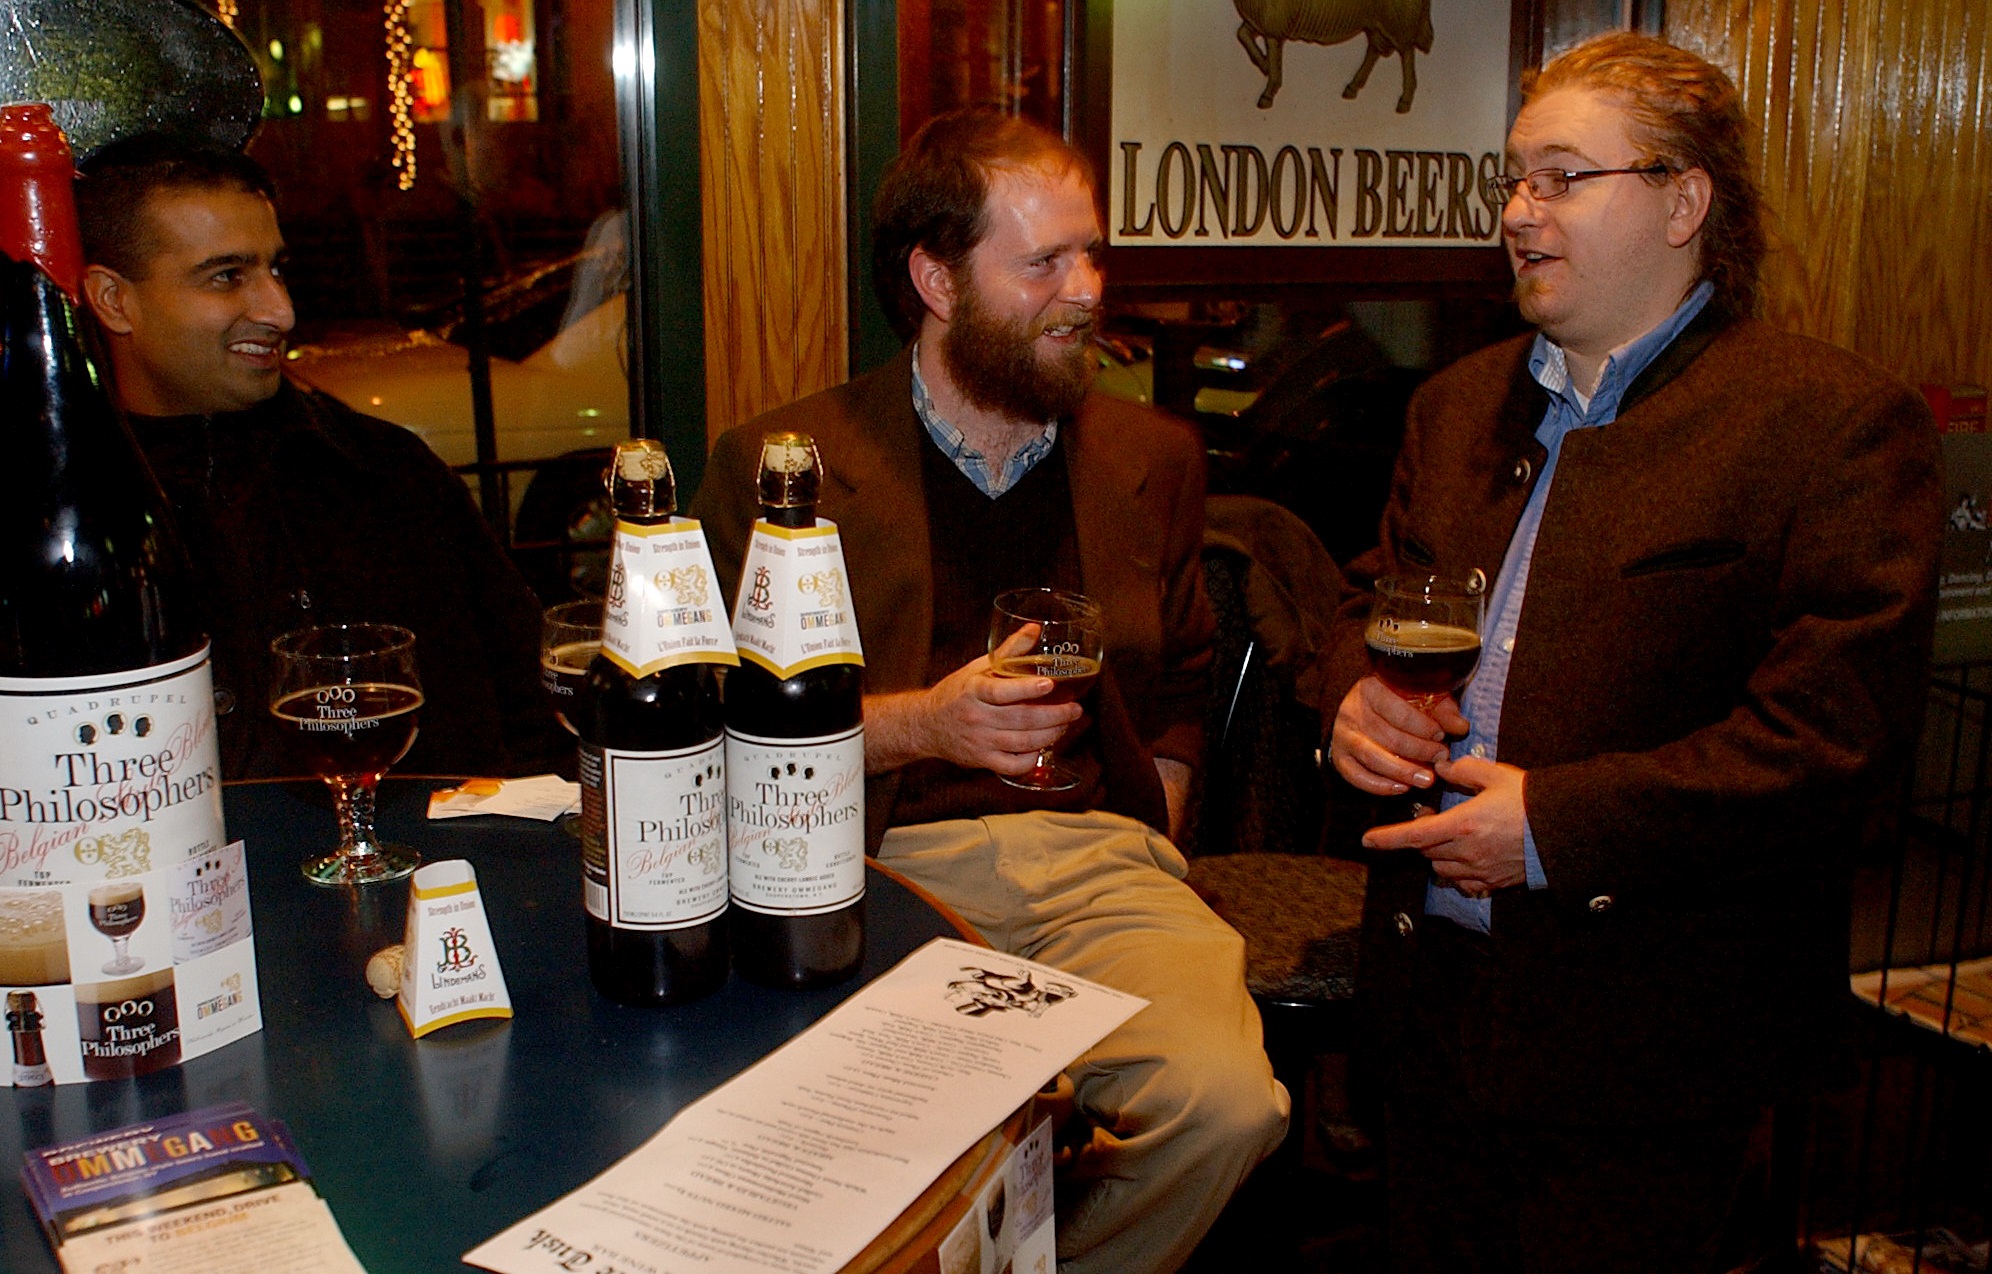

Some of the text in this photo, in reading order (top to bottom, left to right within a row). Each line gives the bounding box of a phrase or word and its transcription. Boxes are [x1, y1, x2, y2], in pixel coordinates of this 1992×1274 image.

[1118, 141, 1500, 240] LONDON BEERS
[657, 609, 713, 628] OMMEGANG
[801, 611, 848, 630] OMMEGANG
[27, 693, 187, 726] QUADRUPEL
[316, 705, 357, 719] Three
[299, 717, 380, 734] Philosophers
[55, 749, 174, 788] Three
[744, 752, 842, 762] QUADRUPEL
[0, 765, 214, 823] Philosophers
[755, 782, 829, 806] Three
[730, 796, 858, 834] Philosophers
[0, 822, 90, 875] Belgian
[649, 878, 686, 886] FERMENTED
[752, 883, 788, 893] BREWERY
[792, 882, 838, 893] OMMEGANG
[428, 903, 453, 917] Strength
[460, 900, 476, 911] Union
[197, 990, 244, 1020] OMMEGANG
[81, 1027, 179, 1057] Philosophers
[106, 1022, 157, 1042] Three
[106, 1229, 143, 1245] THIS
[233, 1194, 280, 1212] DRIVE
[150, 1212, 249, 1245] TO BELGIUM
[522, 1228, 592, 1273] Tusk
[635, 1231, 711, 1262] APPETIZERS
